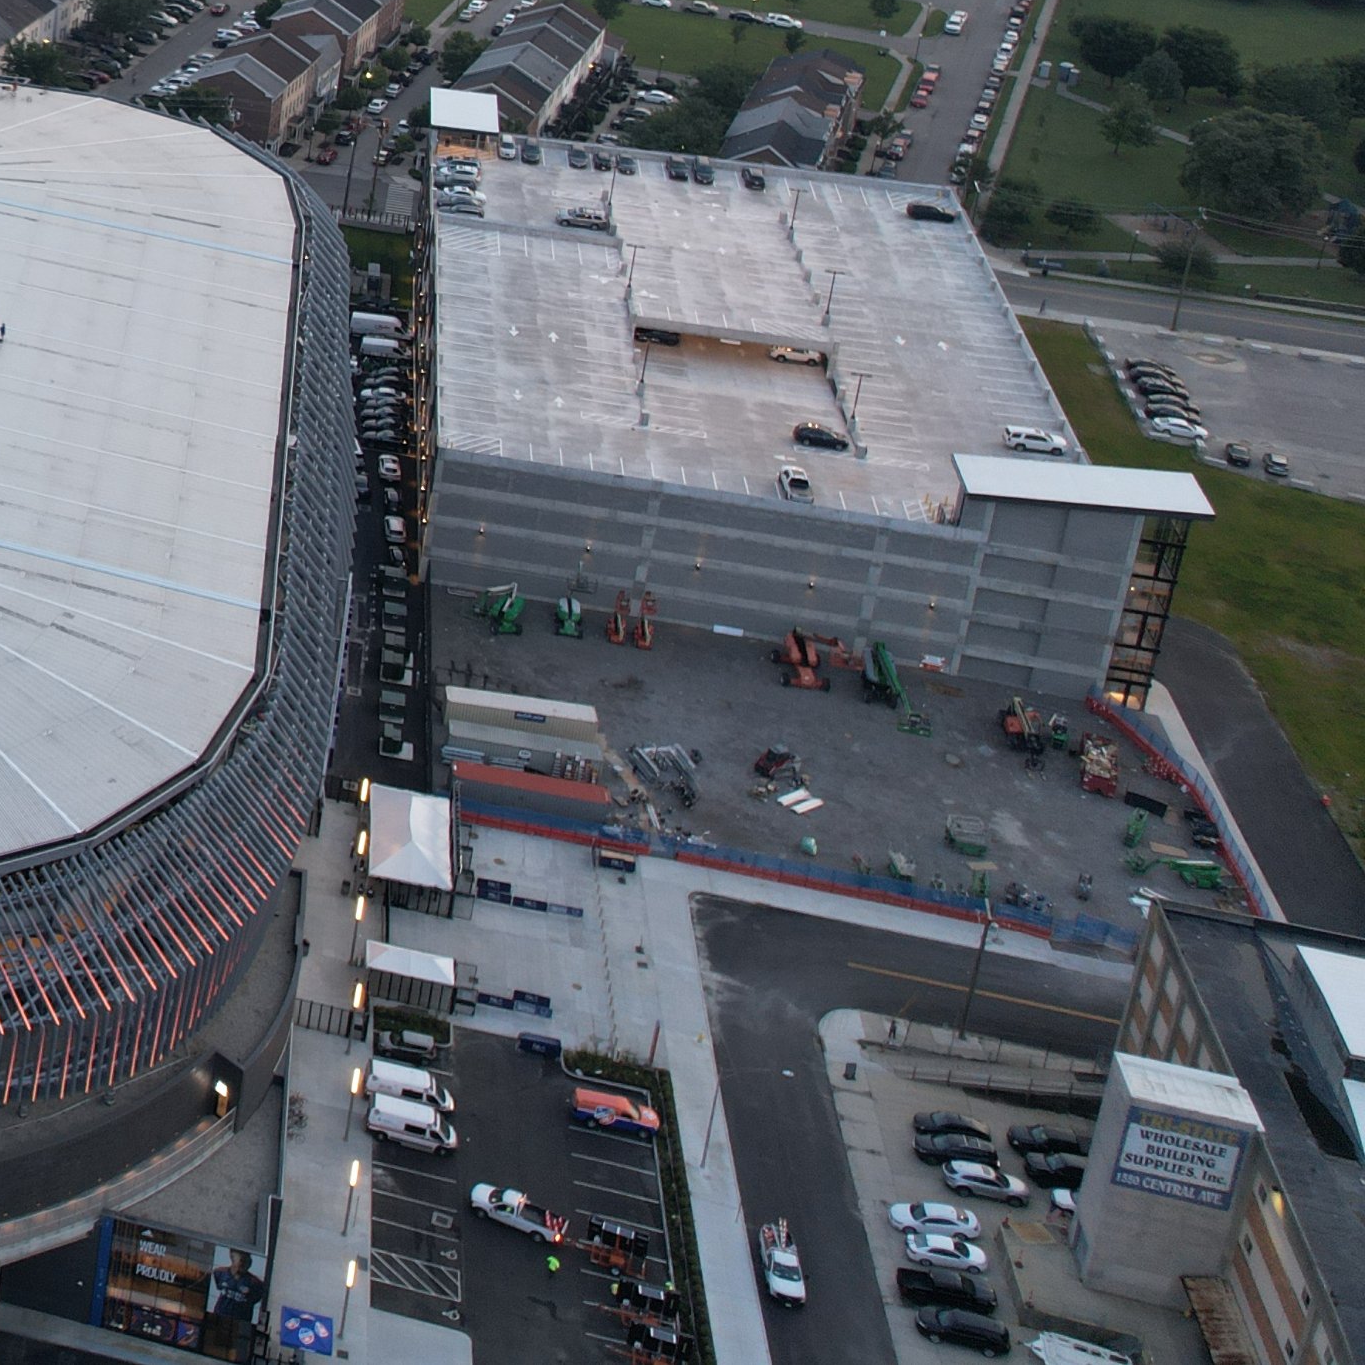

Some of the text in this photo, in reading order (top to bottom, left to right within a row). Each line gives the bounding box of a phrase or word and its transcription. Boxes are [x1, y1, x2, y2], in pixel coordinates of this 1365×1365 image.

[1139, 1129, 1228, 1158] WHOLESALE
[1146, 1143, 1216, 1169] BUILDING
[1201, 1170, 1228, 1186] Inc.
[1141, 1177, 1196, 1199] CENTRAL
[1197, 1190, 1223, 1206] AVE
[139, 1239, 167, 1257] WEAR
[135, 1263, 177, 1284] PROUDLY
